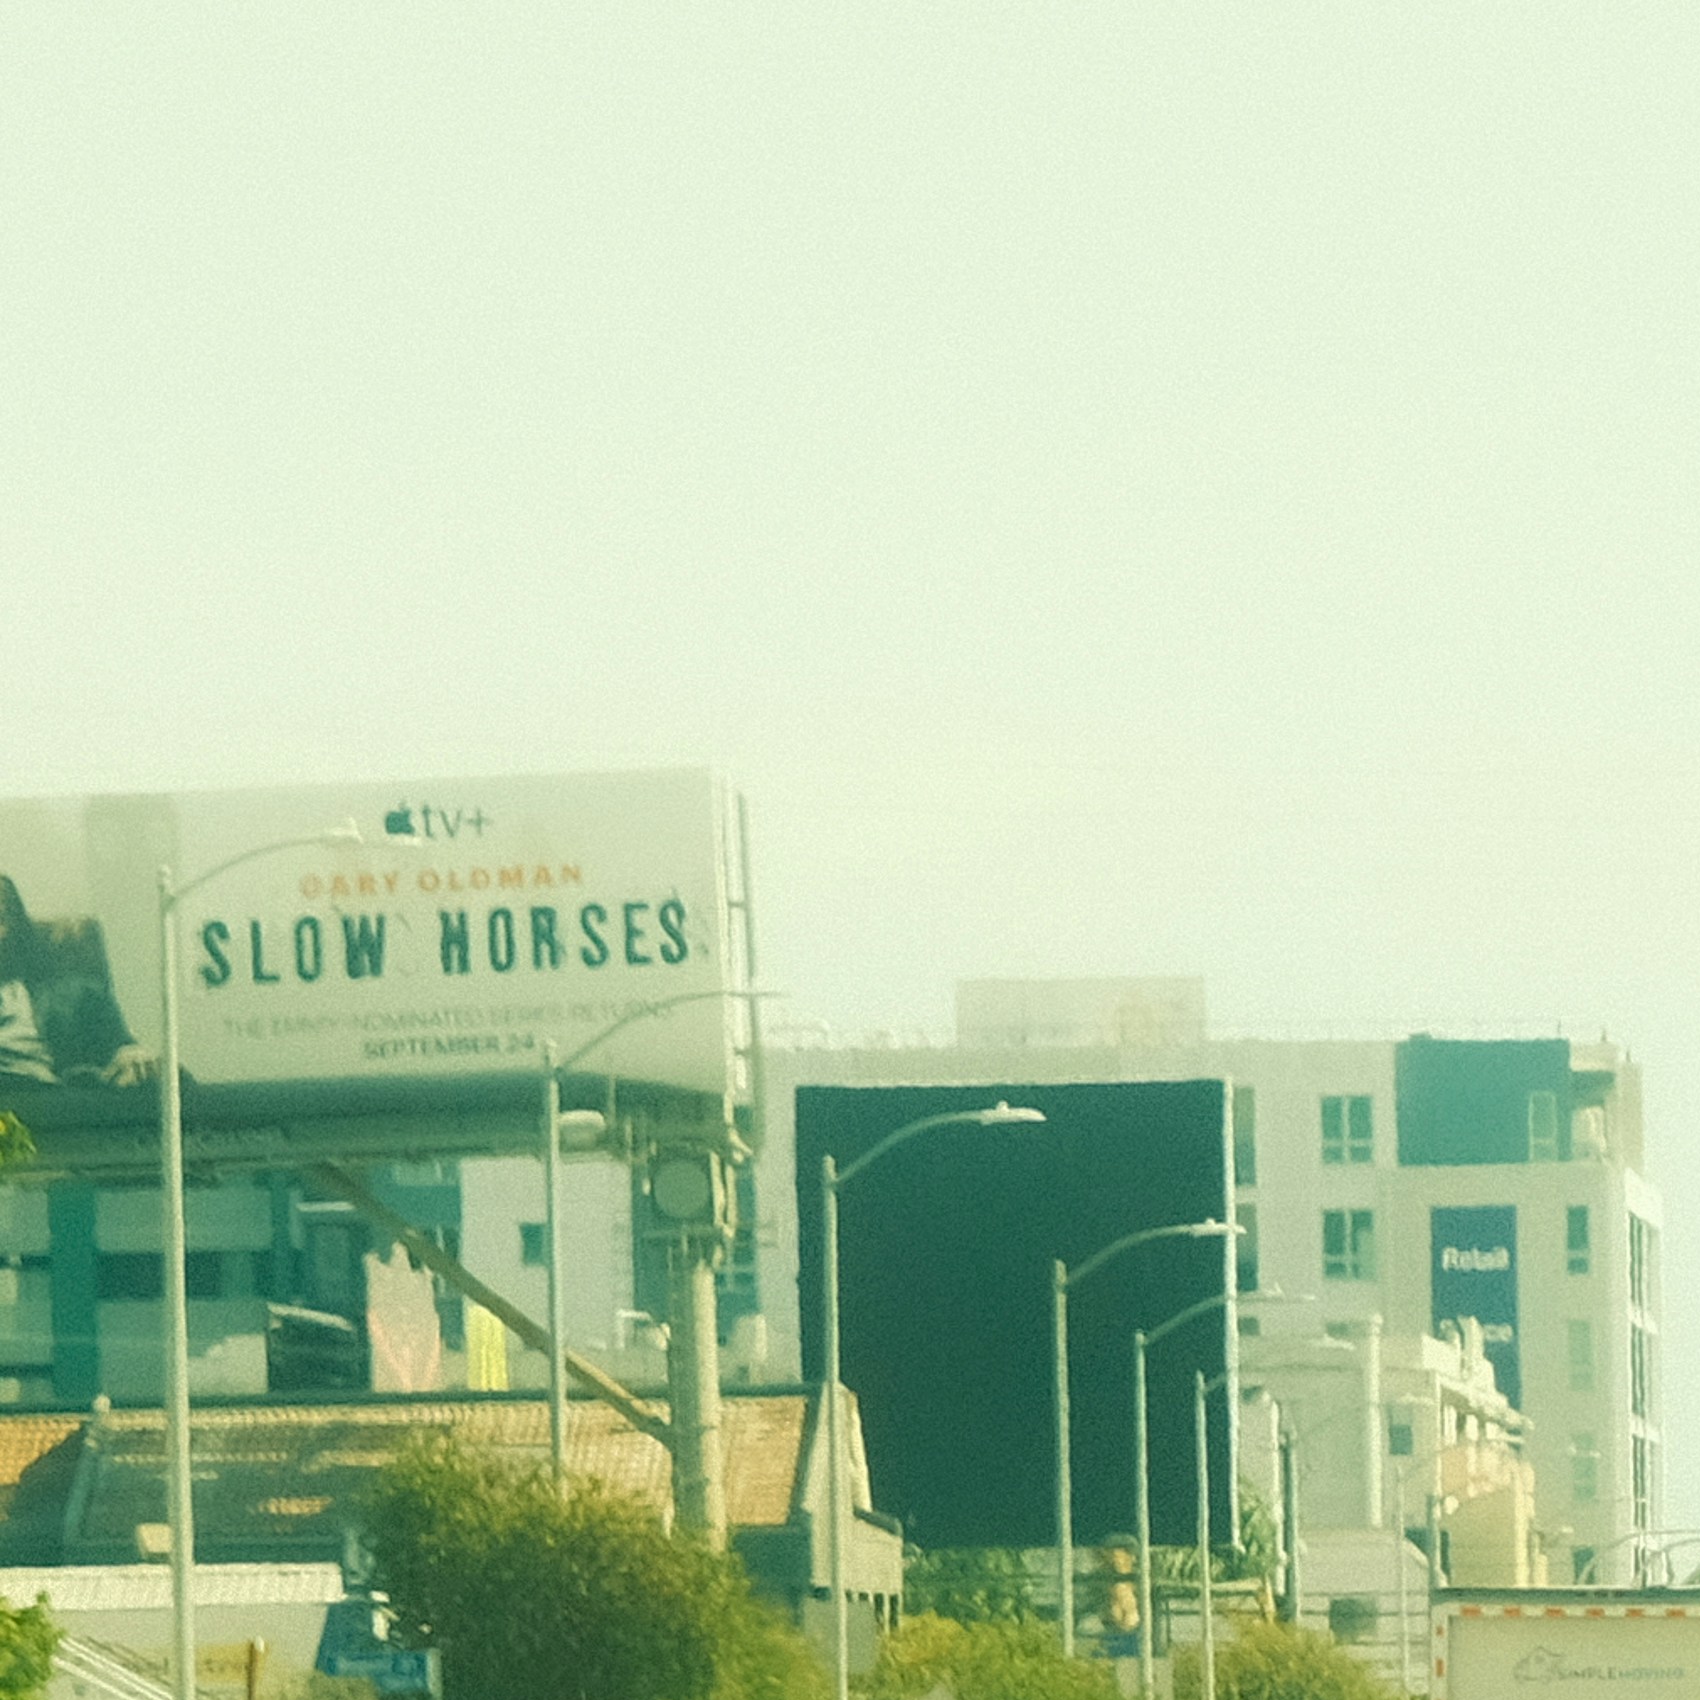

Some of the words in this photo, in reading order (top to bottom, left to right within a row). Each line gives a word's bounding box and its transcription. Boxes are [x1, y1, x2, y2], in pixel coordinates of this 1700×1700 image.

[421, 804, 492, 839] tv+
[301, 869, 399, 900] GARY
[417, 863, 583, 893] OLDMAN
[199, 912, 388, 989] SLOW
[438, 897, 690, 977] HORSES
[362, 1035, 500, 1059] SEPTEMBER
